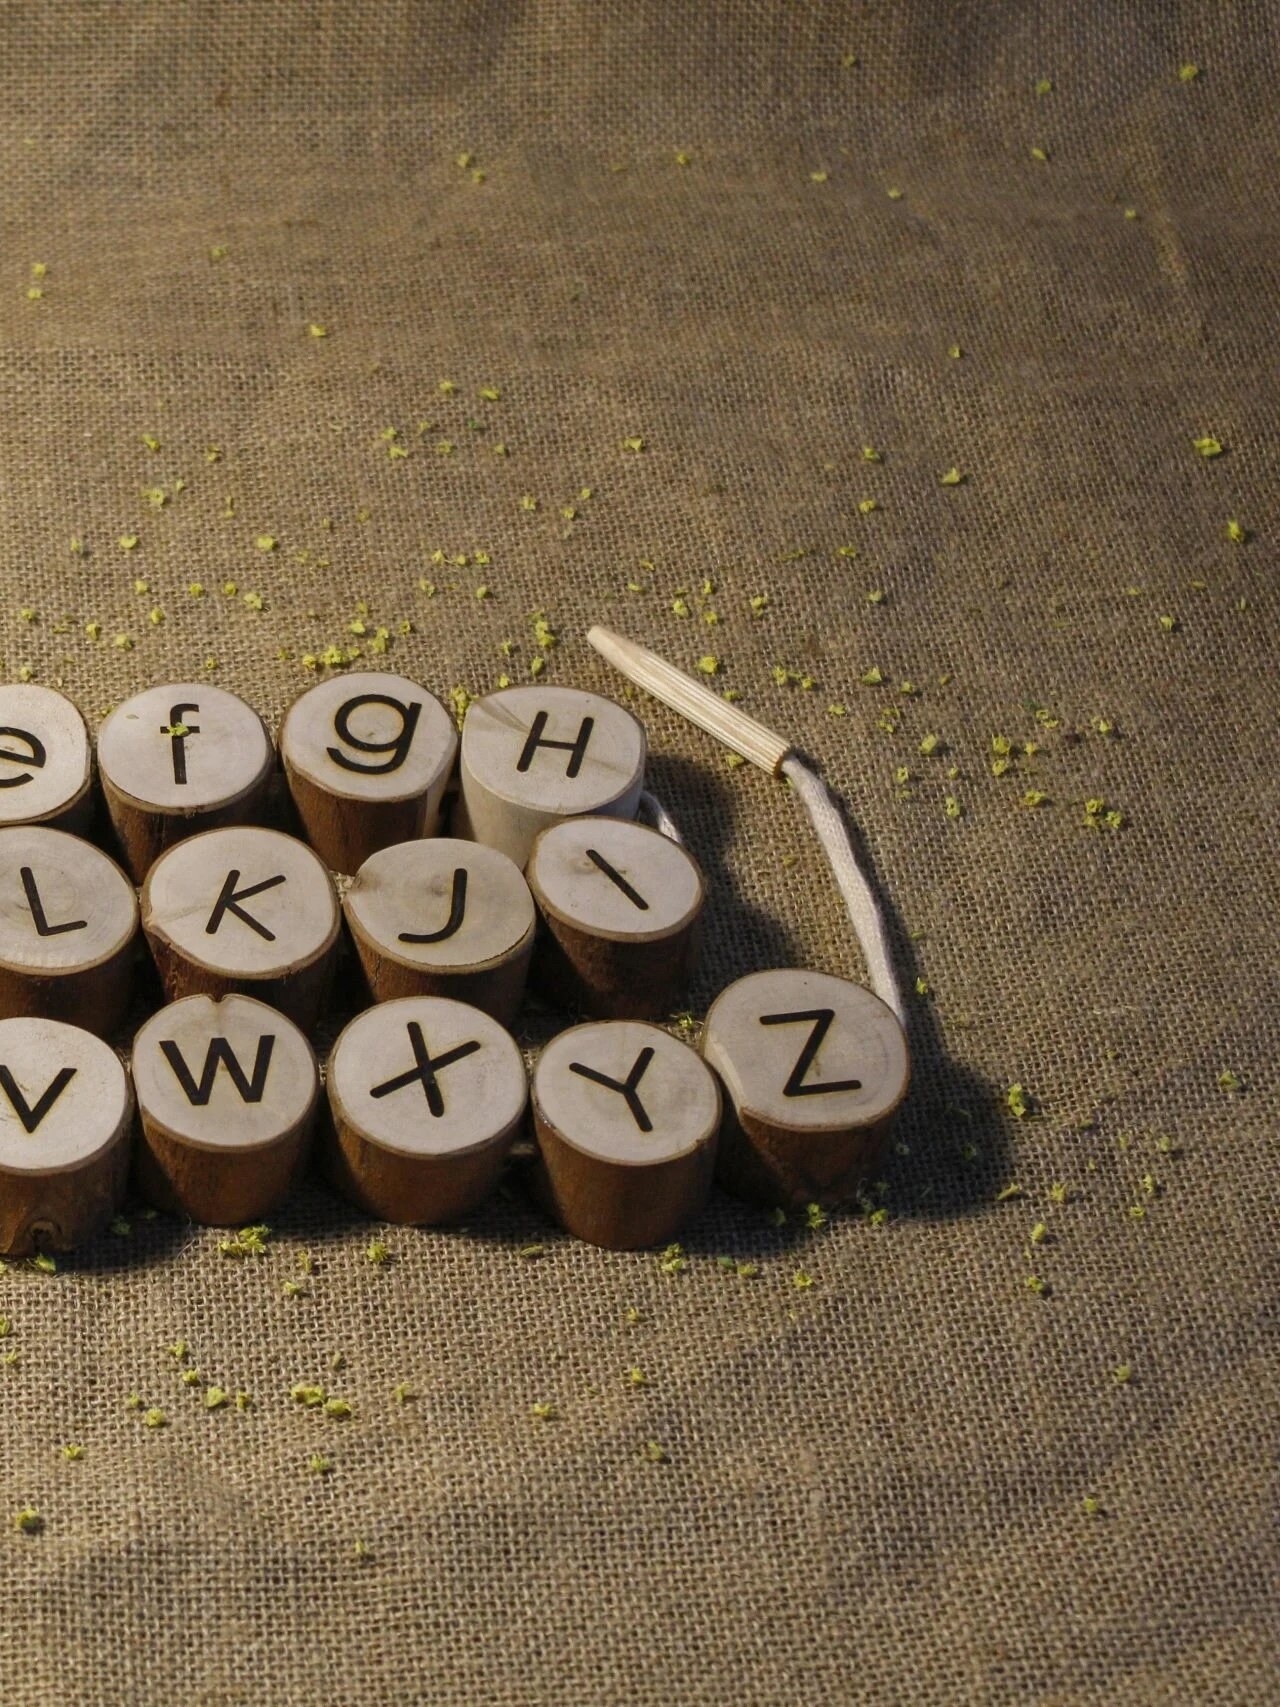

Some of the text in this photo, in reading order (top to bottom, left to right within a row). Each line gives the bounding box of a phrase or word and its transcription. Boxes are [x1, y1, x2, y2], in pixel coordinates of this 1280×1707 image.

[159, 703, 201, 785] f
[327, 694, 422, 775] g
[517, 711, 594, 778] H
[20, 867, 87, 936] L
[206, 870, 286, 941] K
[398, 868, 467, 944] J
[569, 1047, 655, 1132] Y
